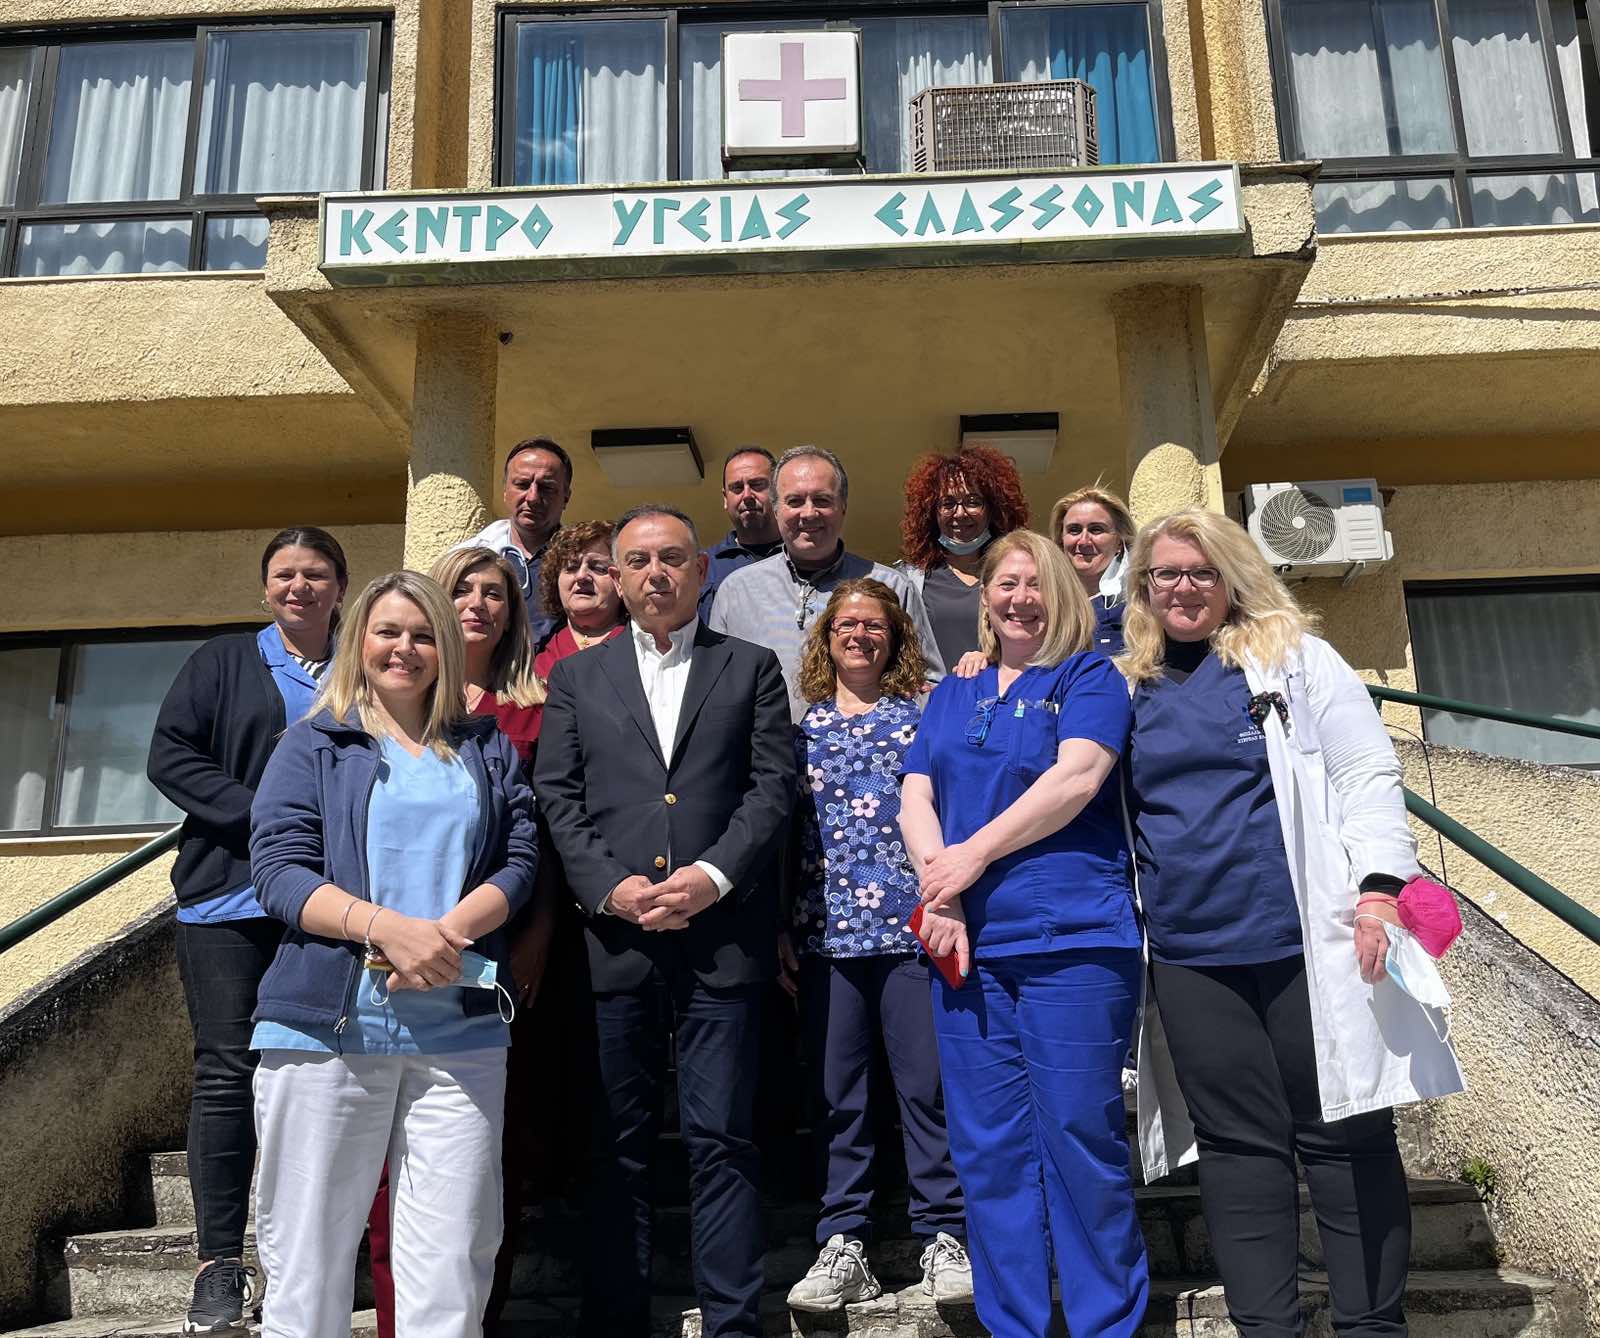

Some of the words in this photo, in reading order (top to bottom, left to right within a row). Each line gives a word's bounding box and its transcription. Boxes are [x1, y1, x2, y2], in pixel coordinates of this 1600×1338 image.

[339, 203, 554, 256] ΚΕΝΤΡΟ
[612, 192, 811, 246] ΥΓΕΙΑΣ
[874, 178, 1224, 237] ΕΛΑΣΣΟΝΑΣ
